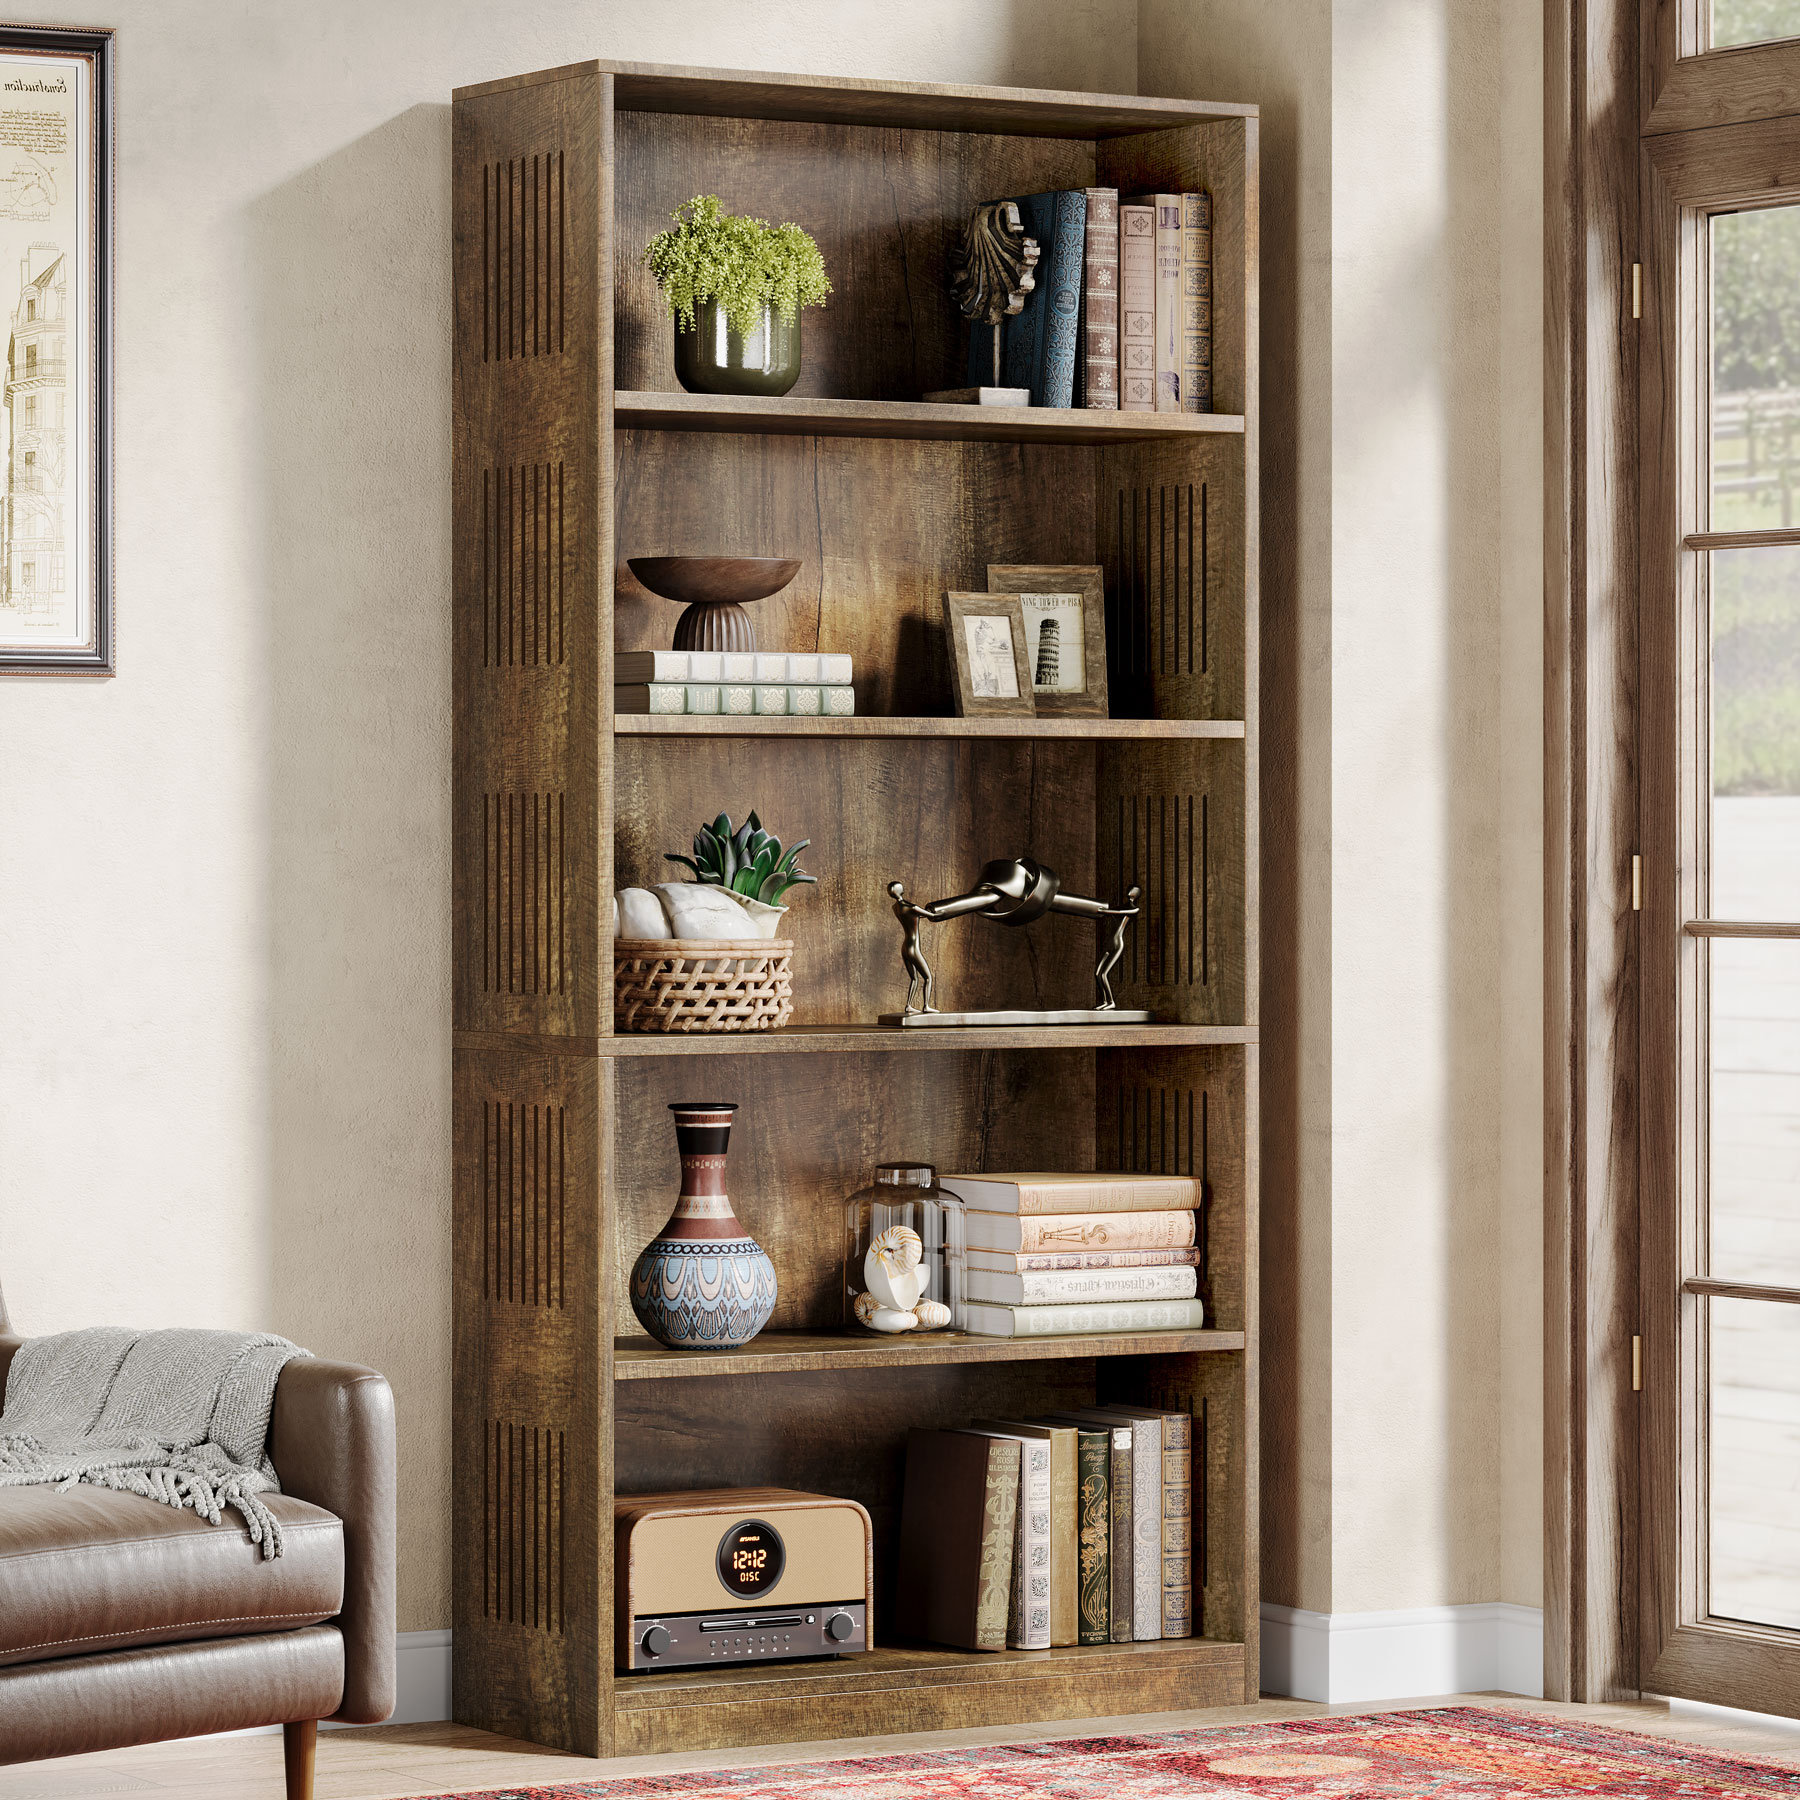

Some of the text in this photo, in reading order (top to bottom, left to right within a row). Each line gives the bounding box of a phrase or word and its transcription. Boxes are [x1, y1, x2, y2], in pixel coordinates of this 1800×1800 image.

[1039, 597, 1059, 607] TOWER
[1067, 597, 1082, 607] PISA
[733, 1549, 767, 1570] 12:12
